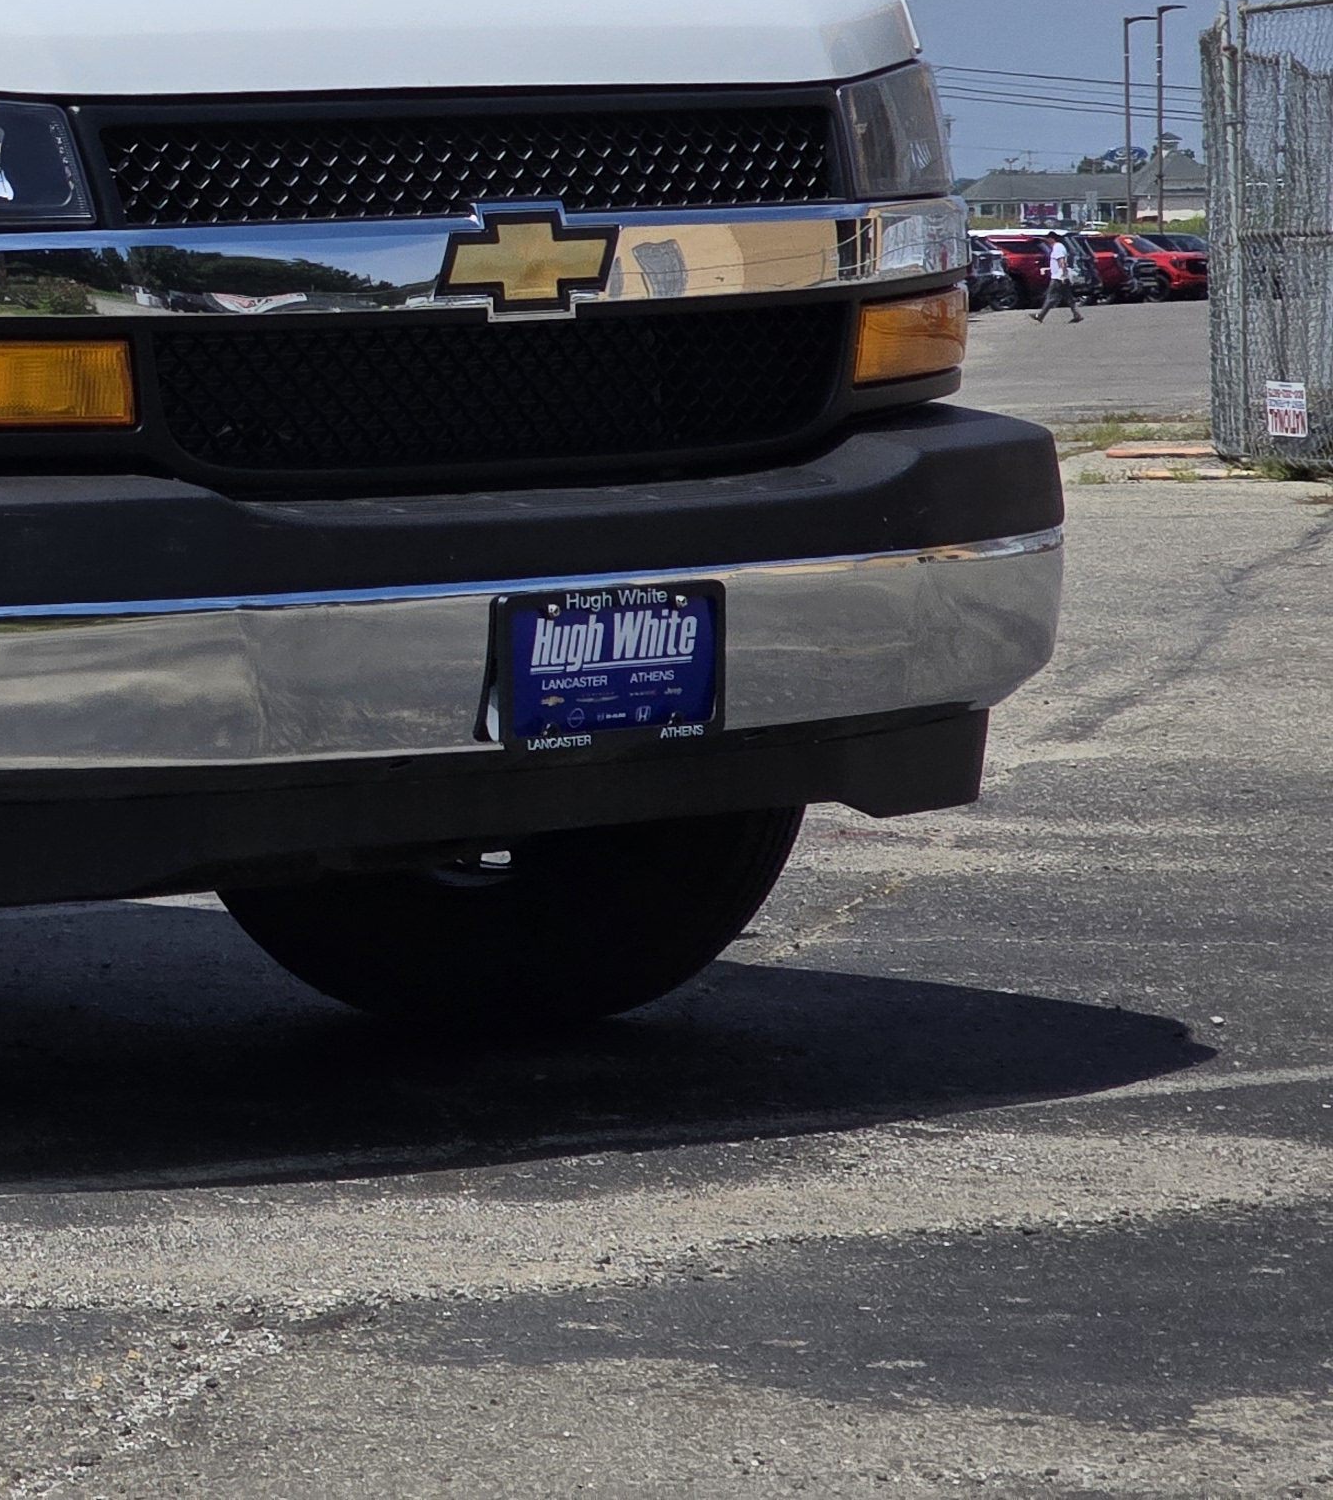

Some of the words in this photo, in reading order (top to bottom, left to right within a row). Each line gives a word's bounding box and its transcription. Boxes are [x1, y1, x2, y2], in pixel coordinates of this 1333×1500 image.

[566, 592, 613, 612] Hugh
[618, 588, 668, 607] White
[531, 614, 604, 672] Hugh
[613, 609, 698, 660] White
[541, 675, 608, 691] LANCASTER
[629, 670, 675, 684] ATHENS
[660, 725, 704, 739] ATHENS
[527, 735, 592, 751] LANCASTER
